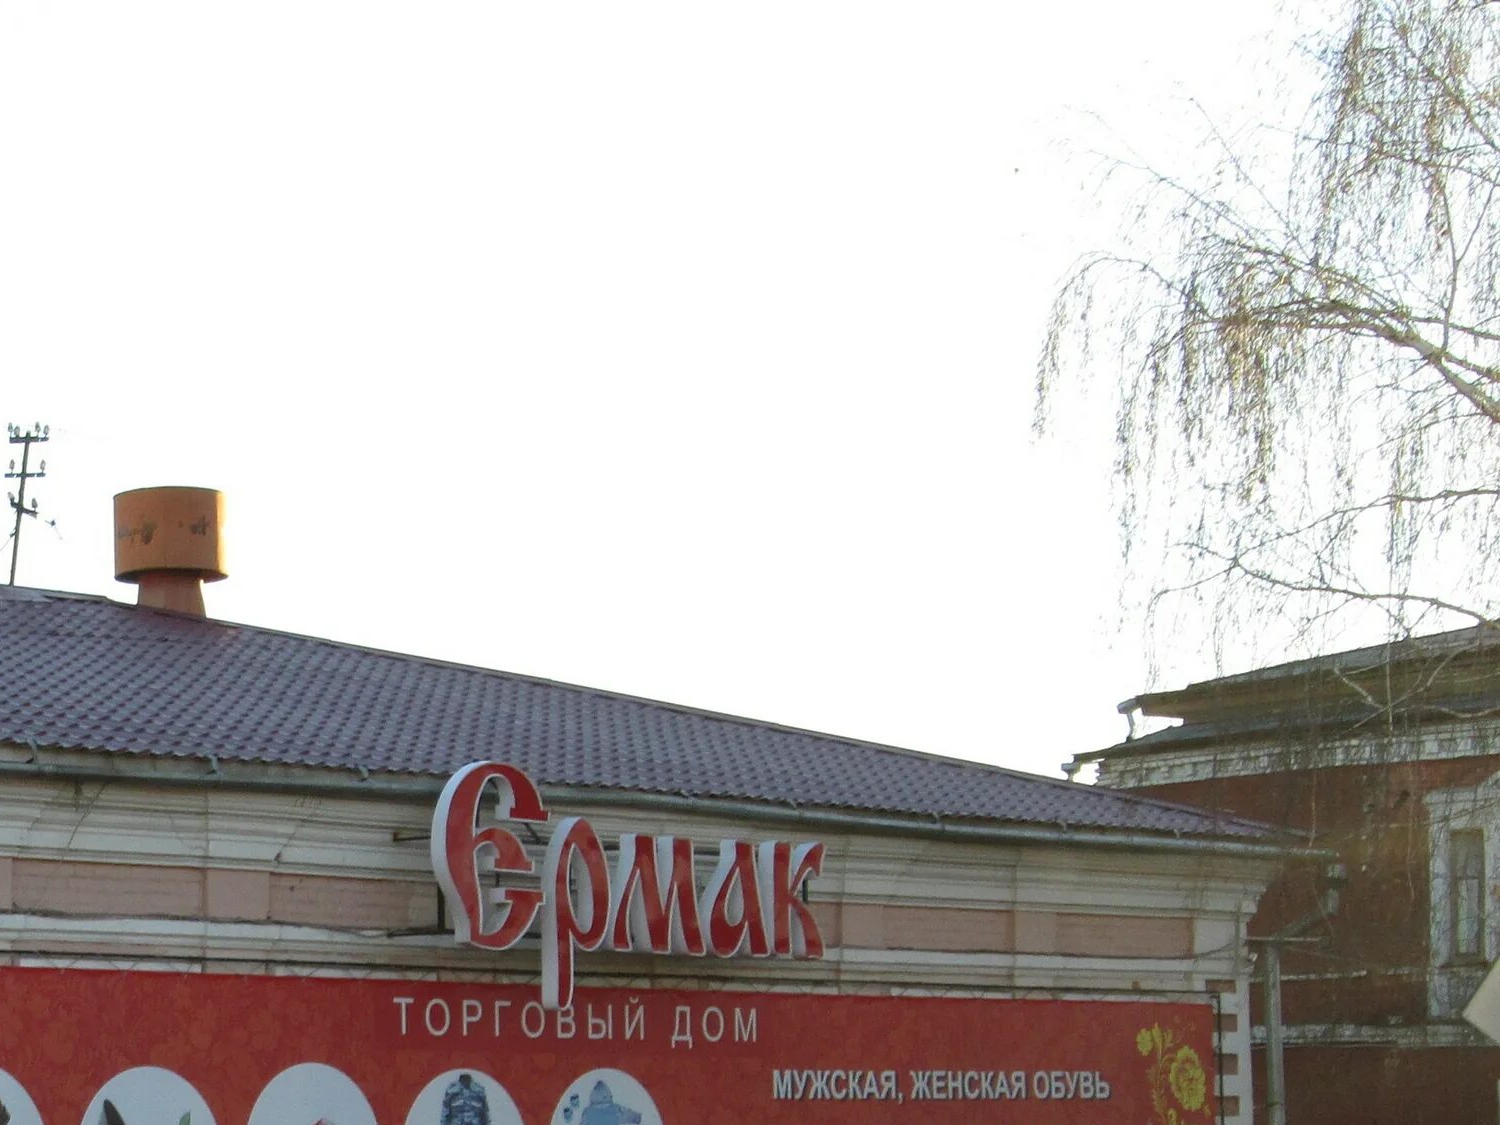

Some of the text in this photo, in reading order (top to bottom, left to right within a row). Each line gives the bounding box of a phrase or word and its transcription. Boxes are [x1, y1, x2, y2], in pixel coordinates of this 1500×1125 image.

[431, 760, 826, 1010] Ермак
[392, 996, 759, 1049] ТОРГОВЫЙ ДОМ
[771, 1068, 1111, 1104] МУЖСКАЯ, ЖЕНСКАЯ ОБУВЬ
